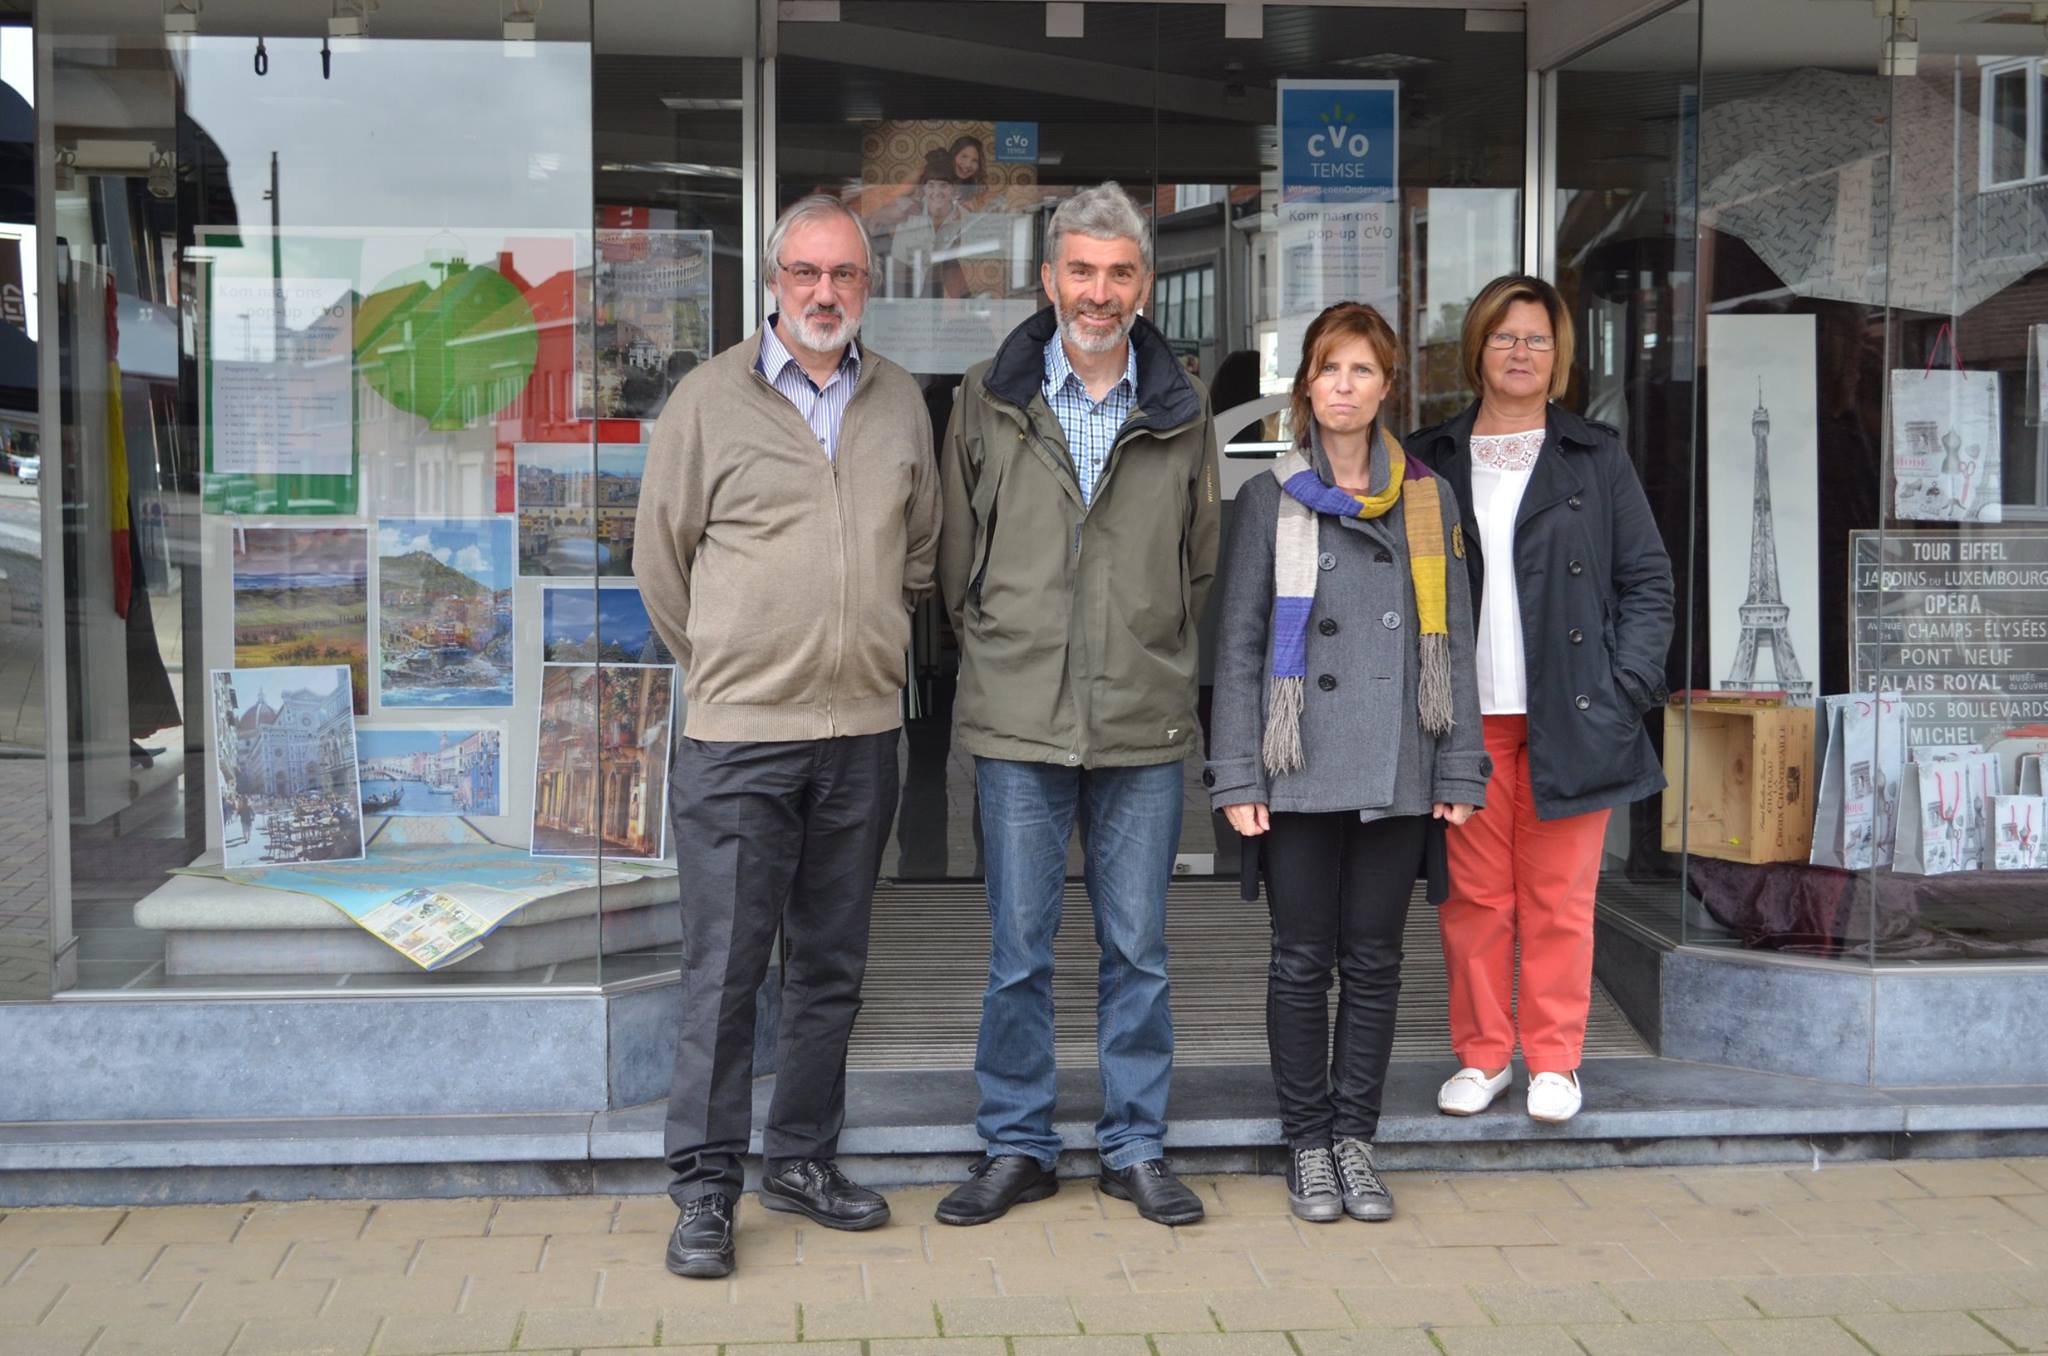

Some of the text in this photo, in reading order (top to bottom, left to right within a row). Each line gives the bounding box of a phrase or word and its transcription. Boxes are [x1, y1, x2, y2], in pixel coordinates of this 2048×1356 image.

[1307, 125, 1369, 158] CVO
[1310, 162, 1365, 178] TEMSE
[1289, 210, 1379, 221] Kom naar ons
[1307, 226, 1393, 241] pop-up CVO
[219, 285, 253, 298] Kom
[295, 288, 321, 298] ons
[1912, 542, 2008, 560] TOUR EIFFEL
[1863, 571, 1927, 587] JARDINS
[1944, 571, 2048, 586] LUXEMBOURG
[1925, 592, 1982, 614] OPÉRA
[1907, 619, 2047, 639] CHAMPS-ÉLYSÉES
[1901, 648, 2013, 665] PONT NEUF
[1868, 673, 2002, 691] PALAIS ROYAL
[1905, 701, 2048, 718] NDS BOULEVARDS
[1910, 727, 1977, 744] MICHEL
